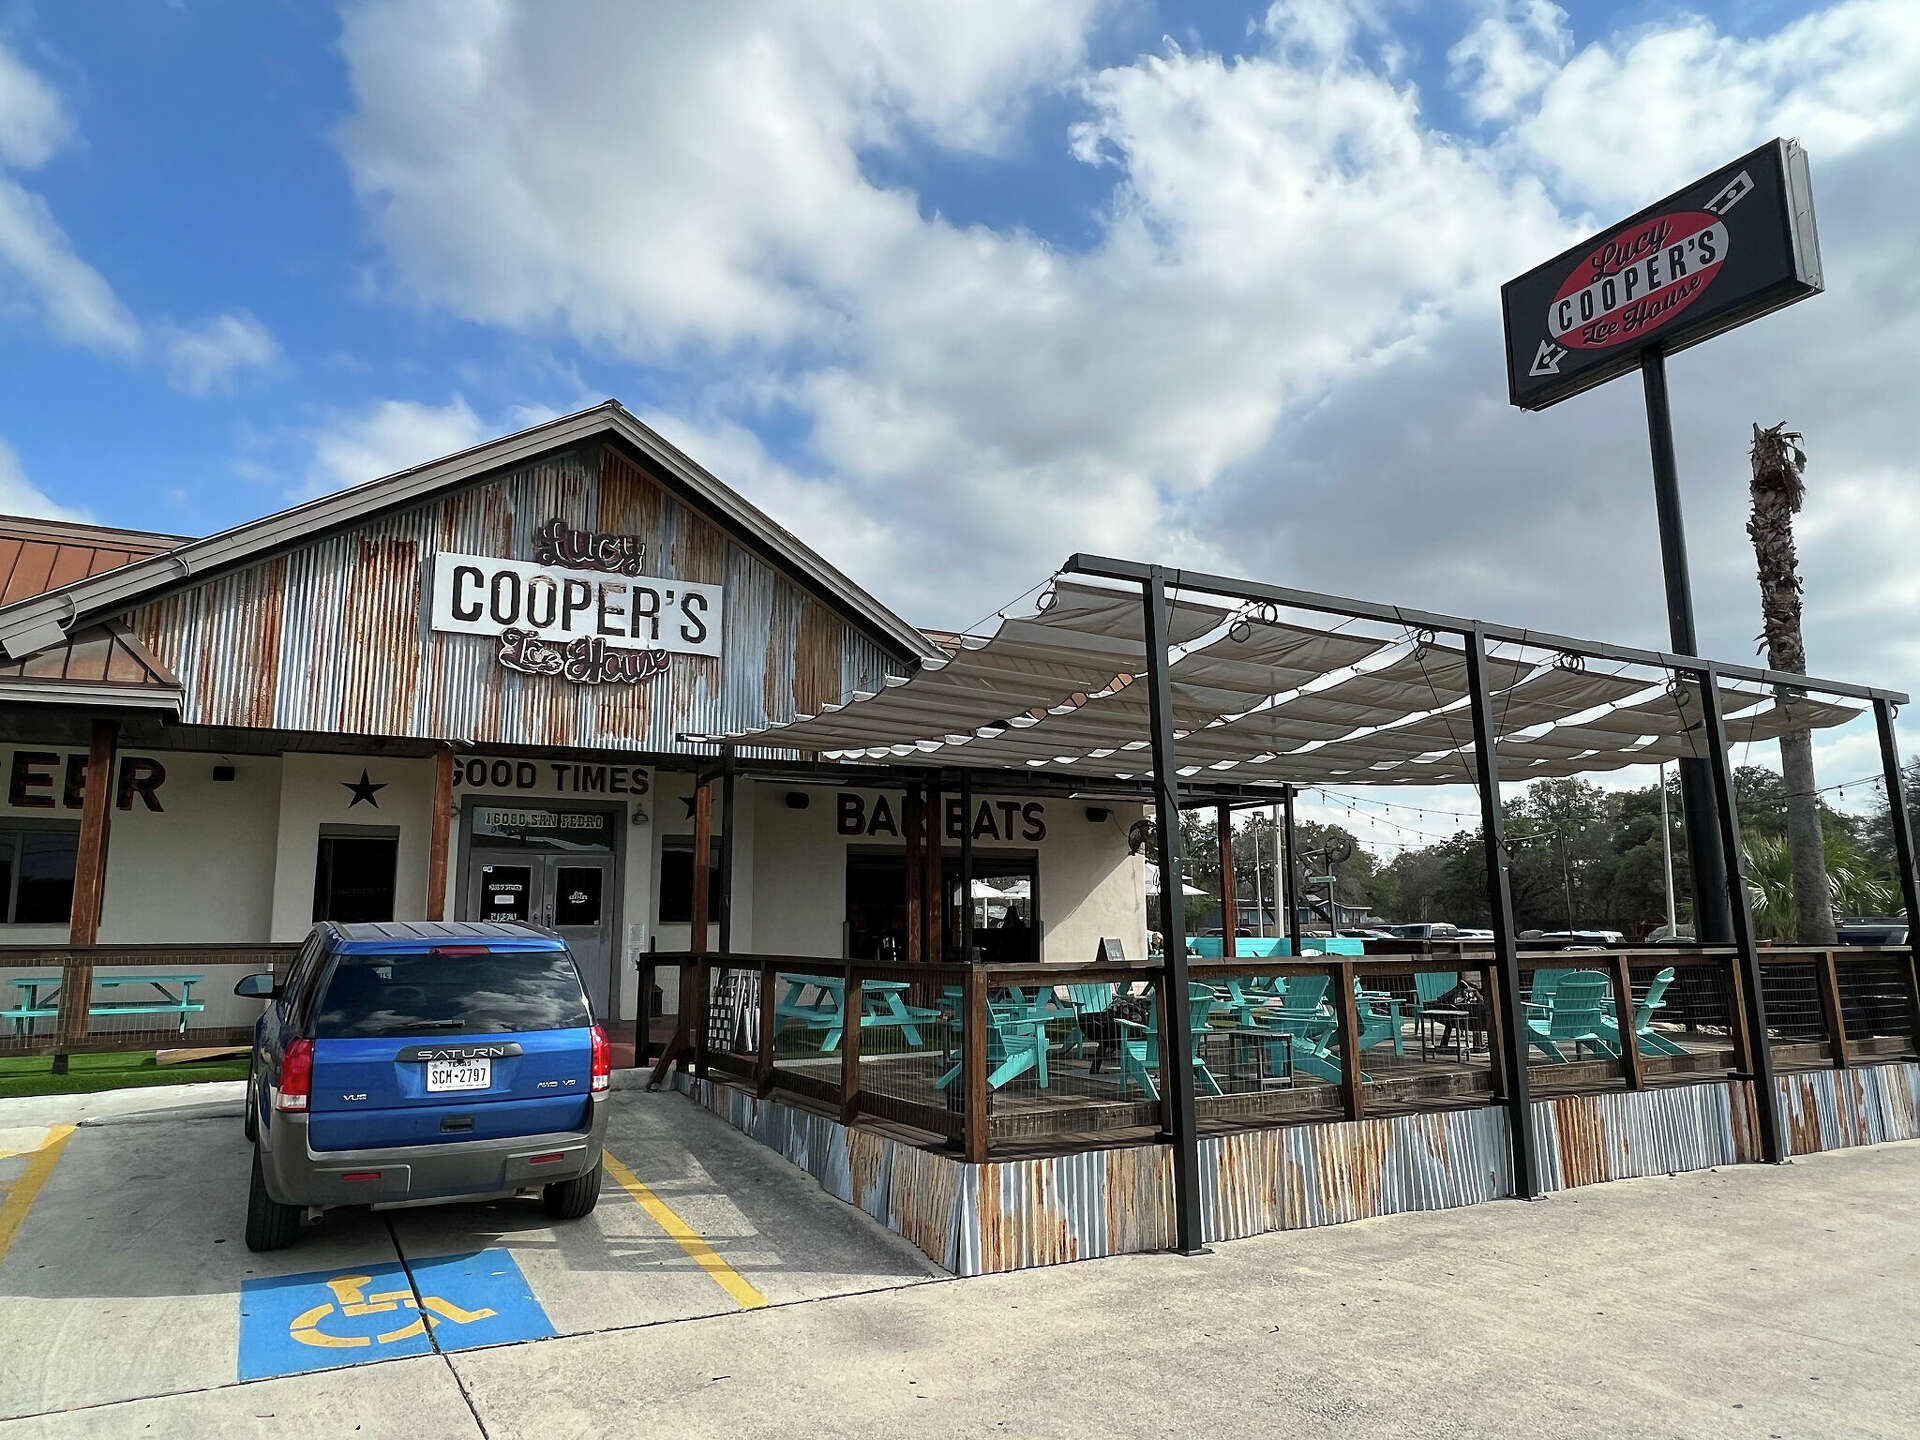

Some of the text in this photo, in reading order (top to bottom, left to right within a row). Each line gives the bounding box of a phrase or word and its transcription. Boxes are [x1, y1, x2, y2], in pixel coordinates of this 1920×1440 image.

[1559, 230, 1717, 331] COOPER'S
[1592, 220, 1672, 283] Lucy
[1582, 275, 1704, 344] Ice House
[451, 565, 708, 644] COOPER'S
[0, 751, 166, 812] EER
[551, 763, 649, 795] TIMES
[837, 792, 1047, 842] BA EATS
[417, 1047, 504, 1060] SATURN
